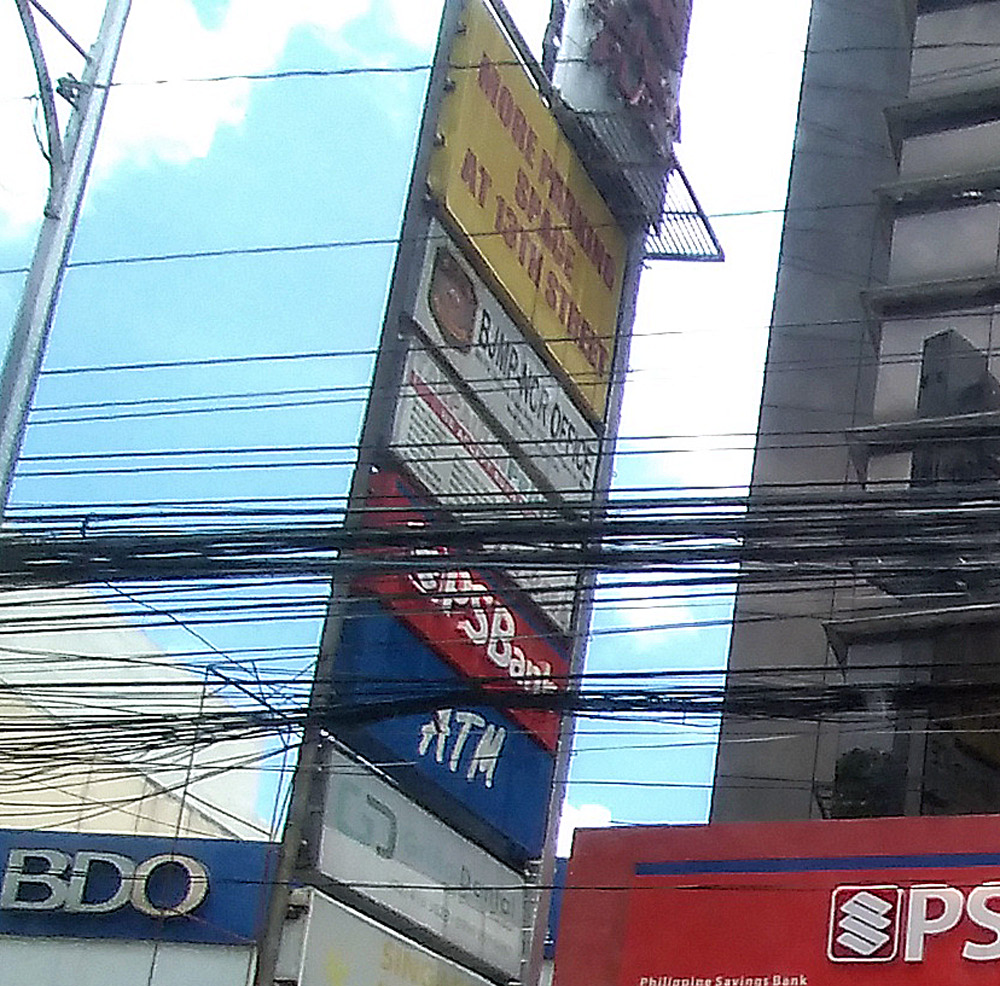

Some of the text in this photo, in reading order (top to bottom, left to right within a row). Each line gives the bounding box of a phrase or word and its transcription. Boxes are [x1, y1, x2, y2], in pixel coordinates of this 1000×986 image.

[478, 50, 538, 170] MORE
[460, 147, 493, 209] AT
[419, 708, 507, 789] ATM
[1, 848, 210, 918] BDO
[772, 974, 808, 986] Bank
